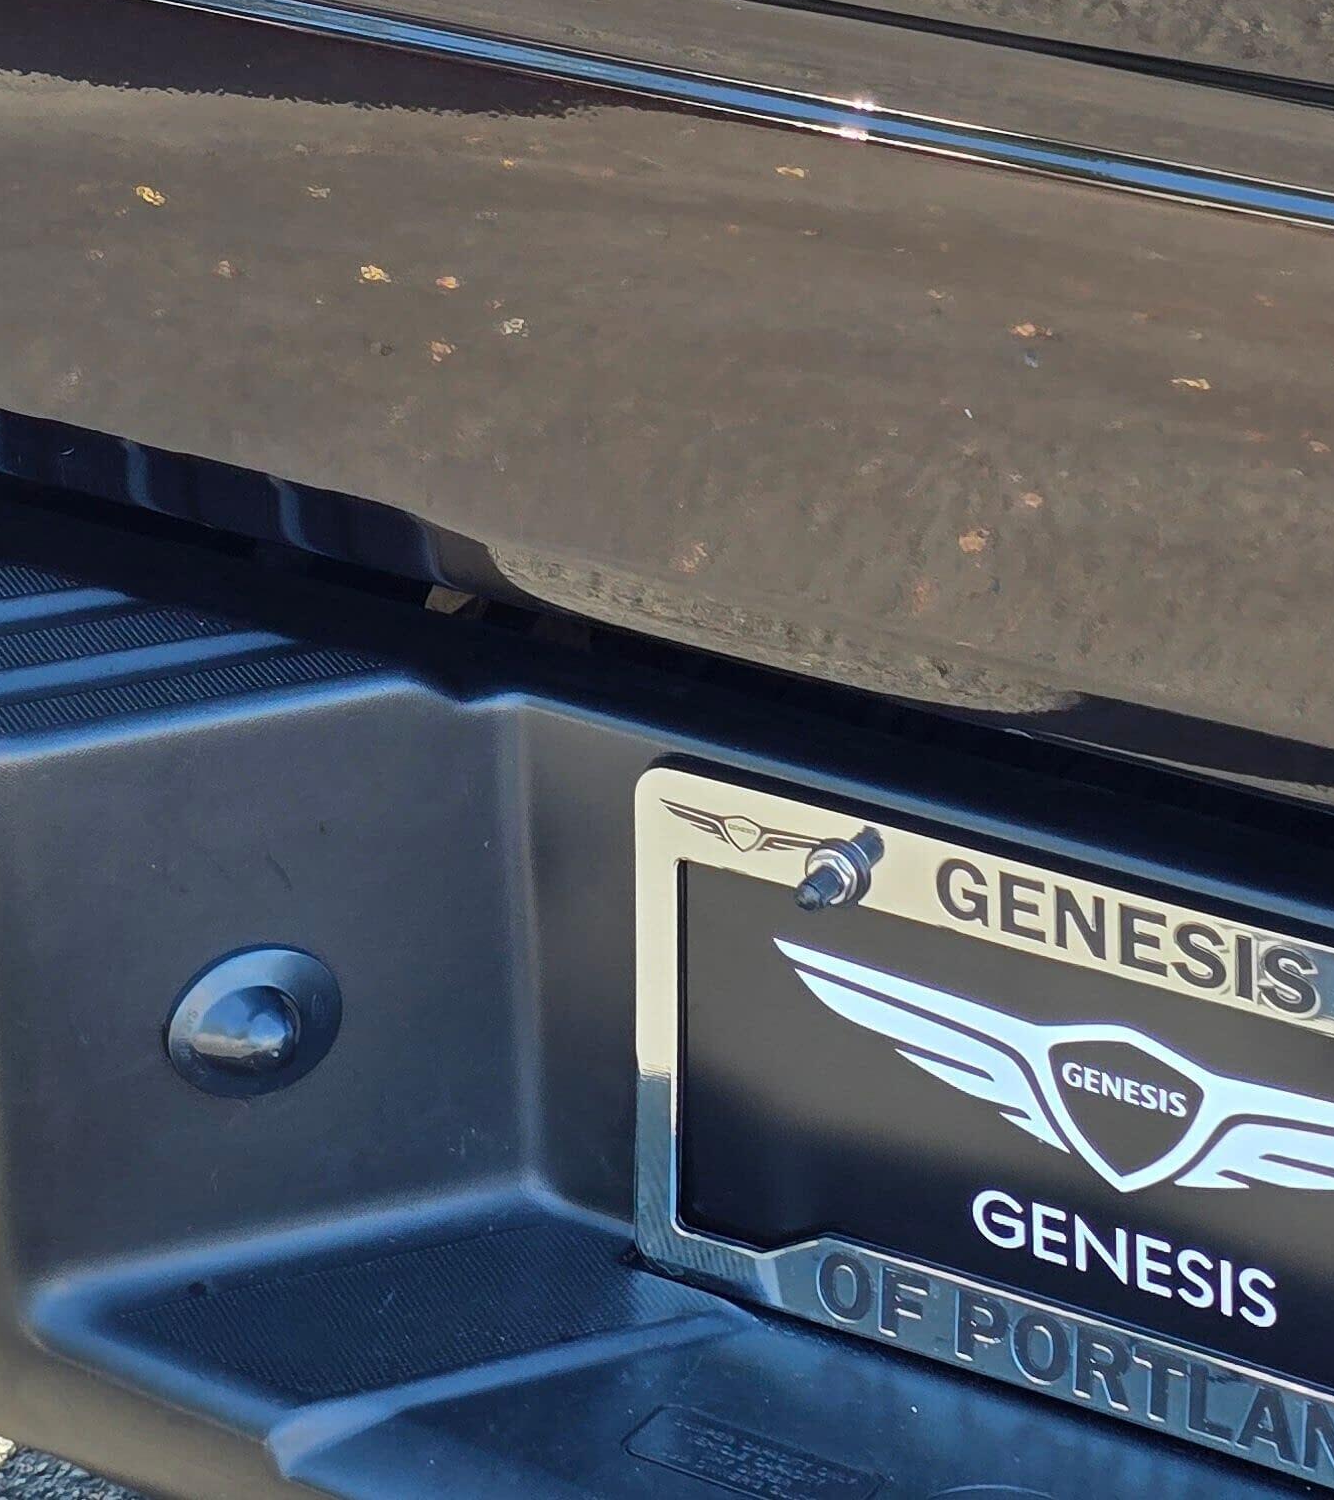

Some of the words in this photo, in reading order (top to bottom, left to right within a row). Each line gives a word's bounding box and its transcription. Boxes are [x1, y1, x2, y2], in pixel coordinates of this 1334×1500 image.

[935, 858, 1321, 1018] GENESIS
[1061, 1061, 1187, 1118] GENESIS
[815, 1253, 931, 1339] OF
[971, 1190, 1278, 1328] GENESIS
